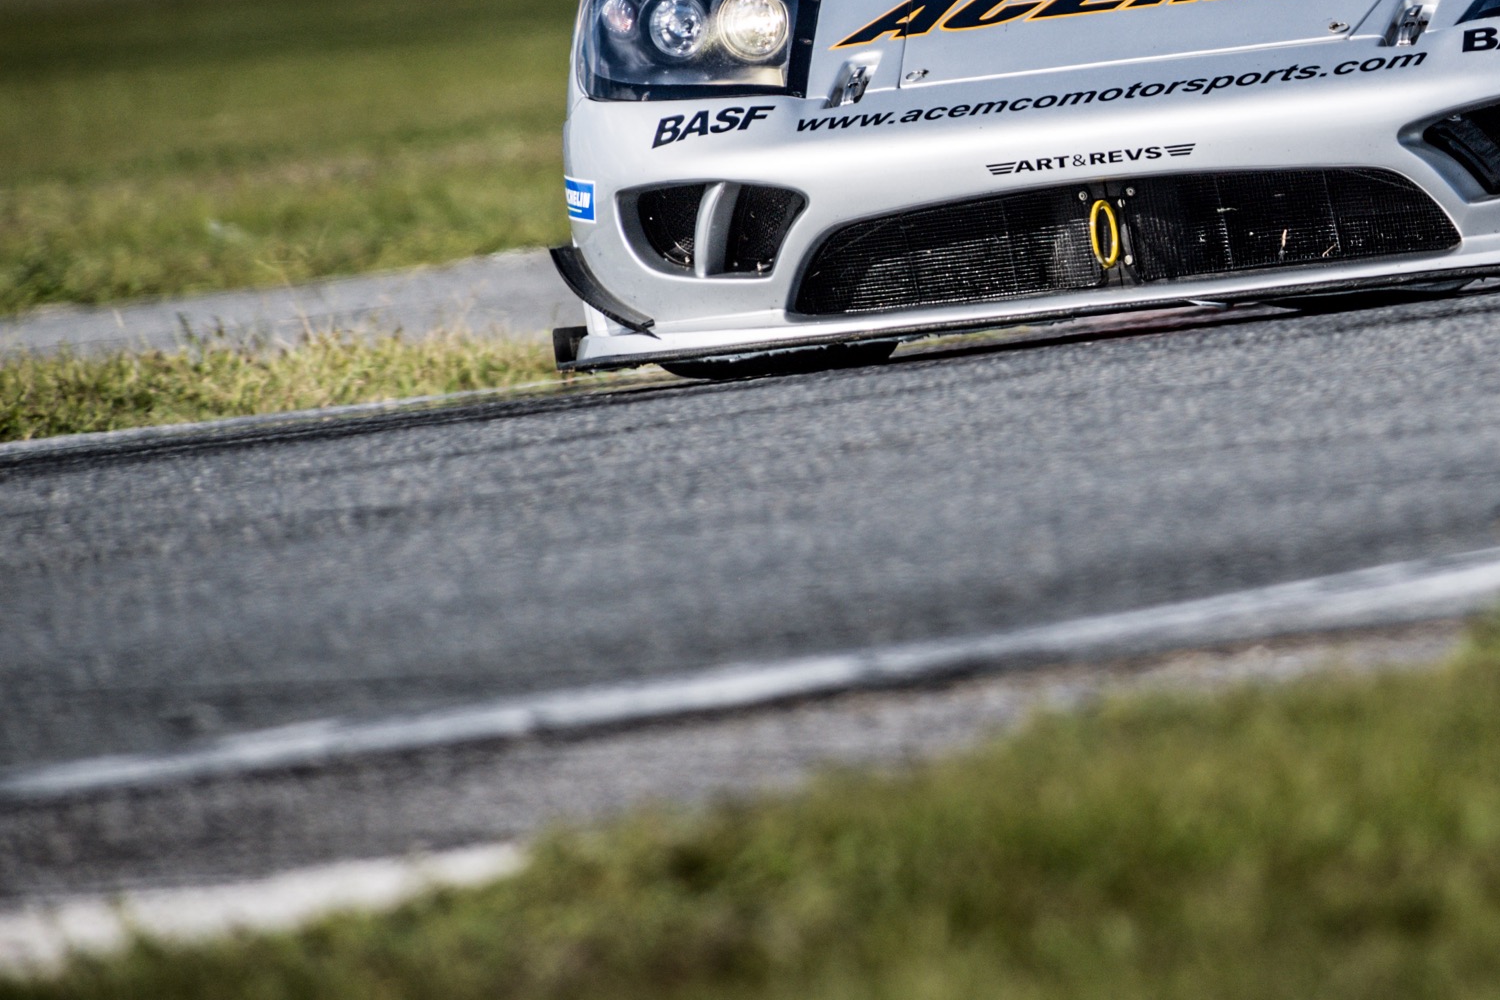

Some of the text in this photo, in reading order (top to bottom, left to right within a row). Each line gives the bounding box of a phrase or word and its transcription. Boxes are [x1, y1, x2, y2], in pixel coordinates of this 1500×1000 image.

[796, 49, 1429, 133] www.acemcomotorsports.com
[651, 105, 776, 149] BASF
[1014, 146, 1163, 174] ART&REVS
